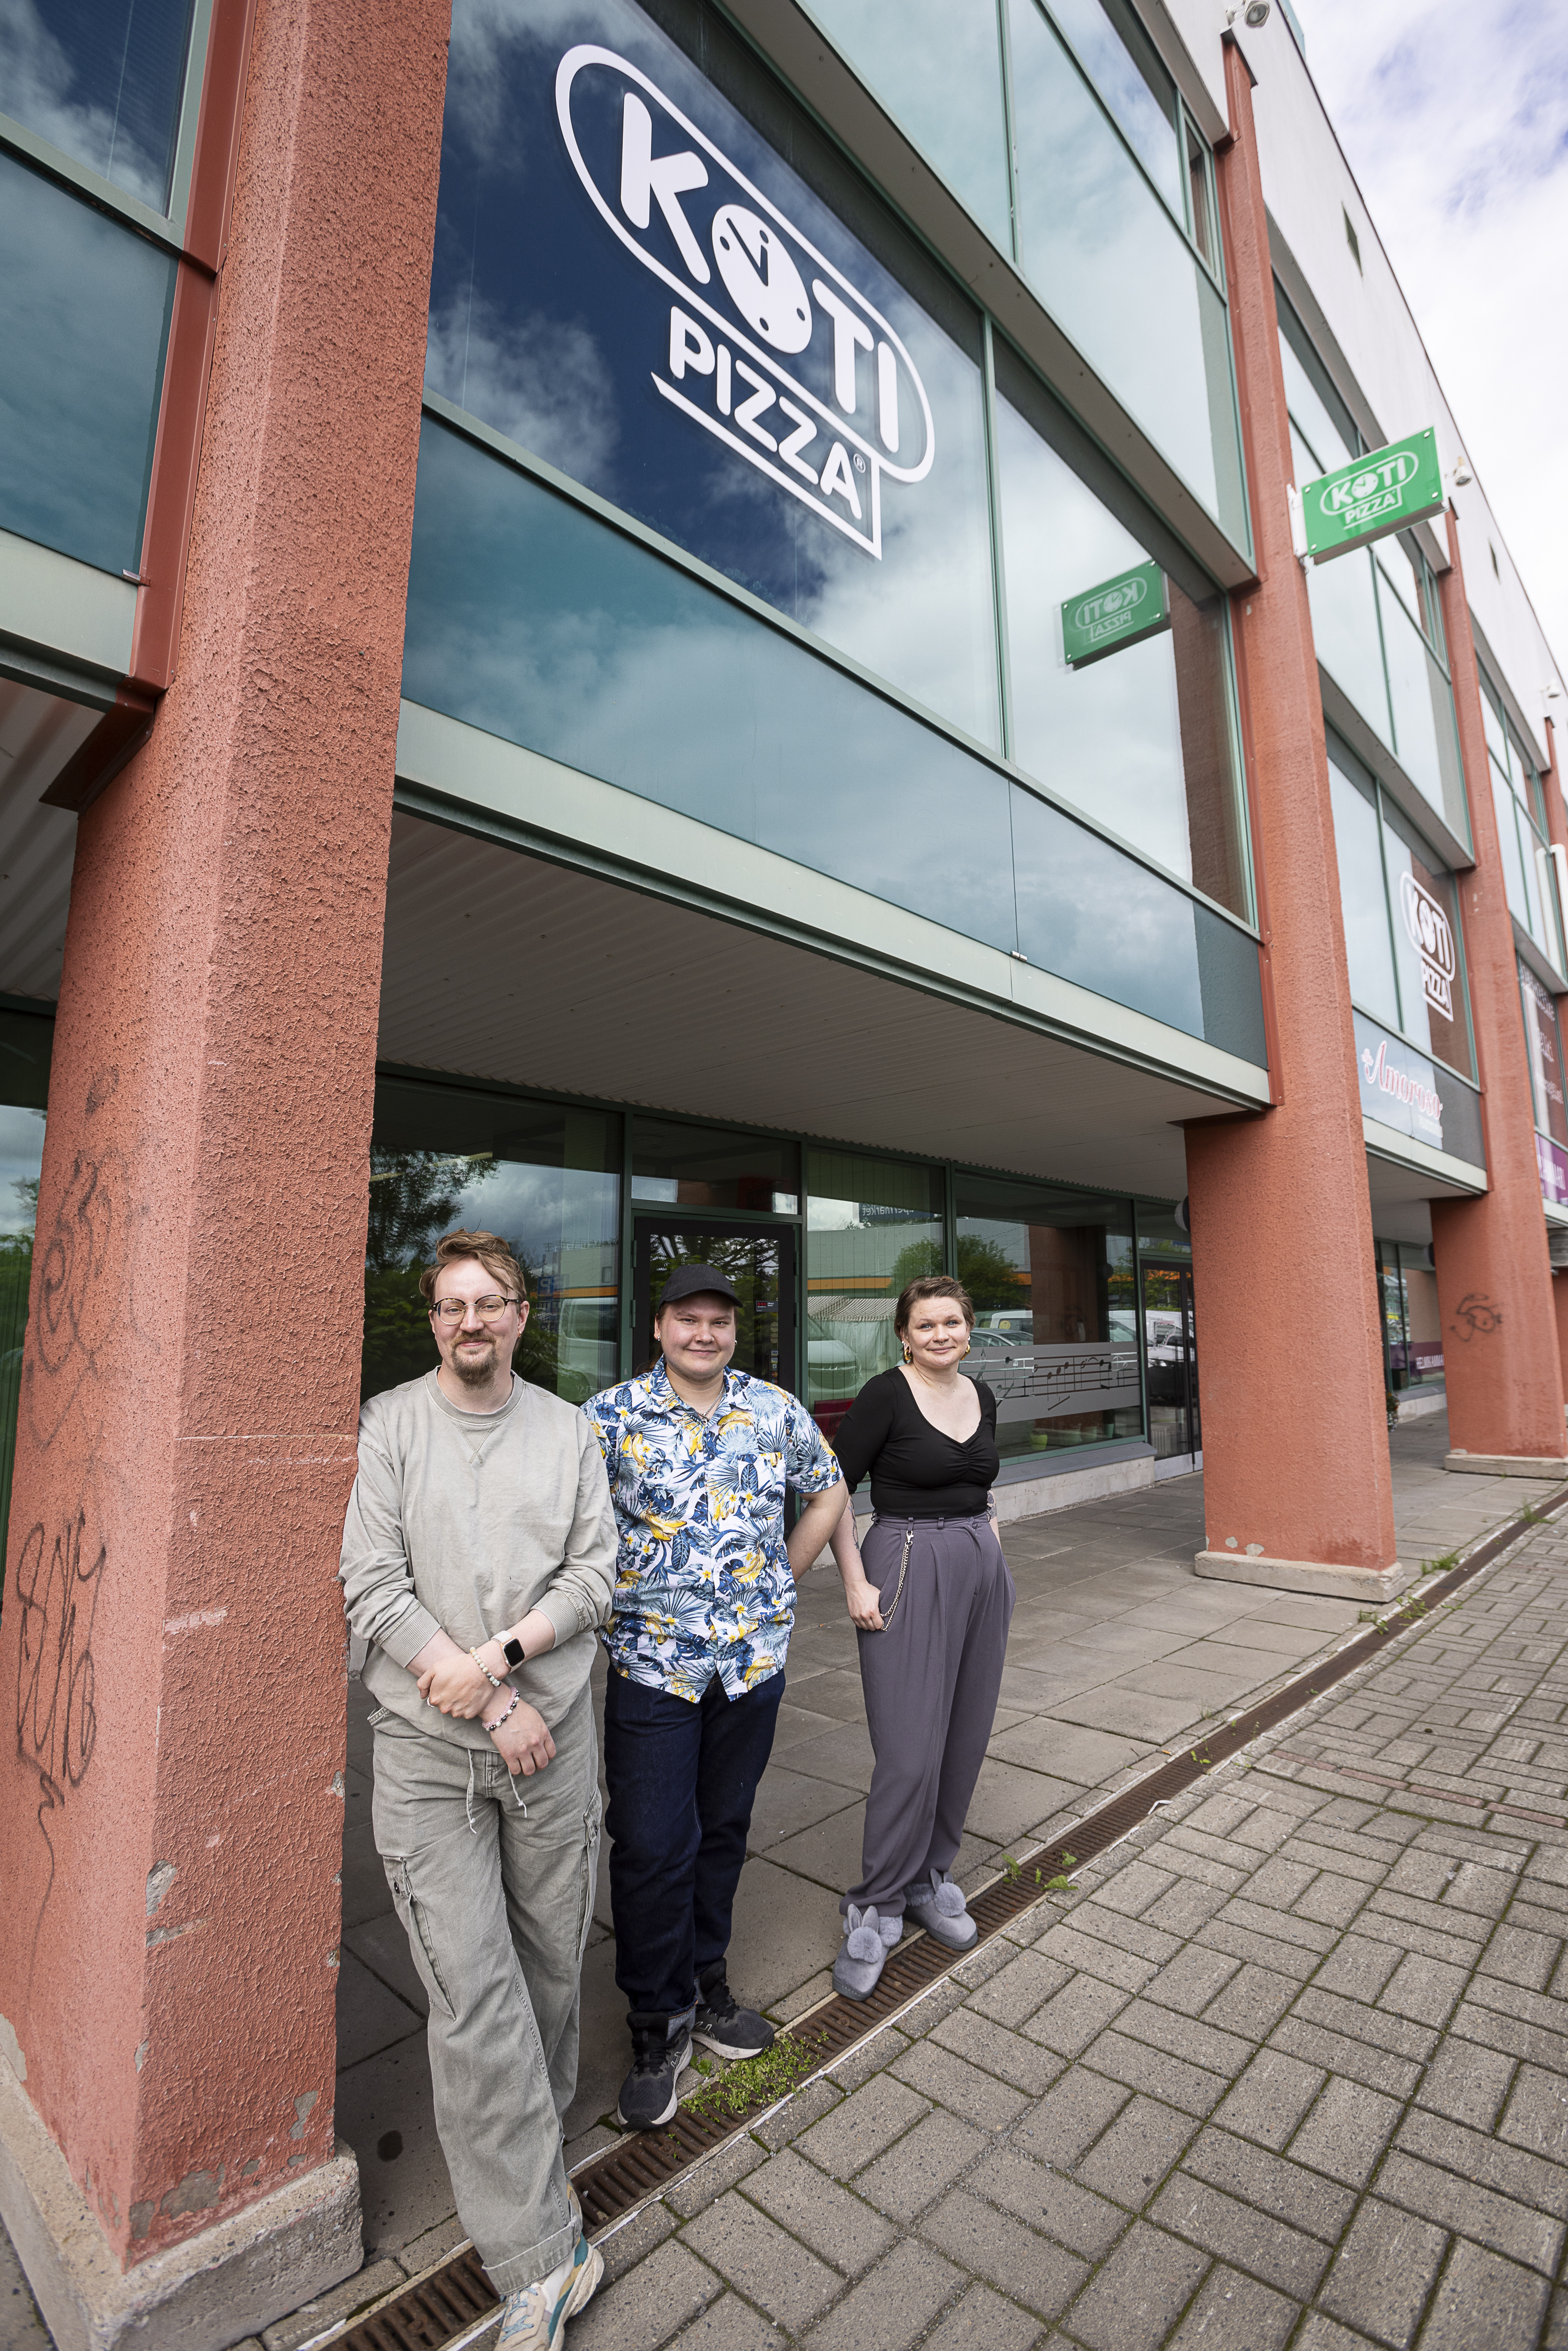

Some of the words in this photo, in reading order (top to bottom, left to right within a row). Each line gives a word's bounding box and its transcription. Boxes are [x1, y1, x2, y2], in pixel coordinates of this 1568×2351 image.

[620, 92, 900, 453] KOTI
[1330, 457, 1407, 510] KOTI
[1344, 491, 1397, 525] PIZZA
[1406, 883, 1451, 971] KOTI
[1420, 960, 1450, 1009] PIZZA
[1365, 1040, 1444, 1120] Amoroso
